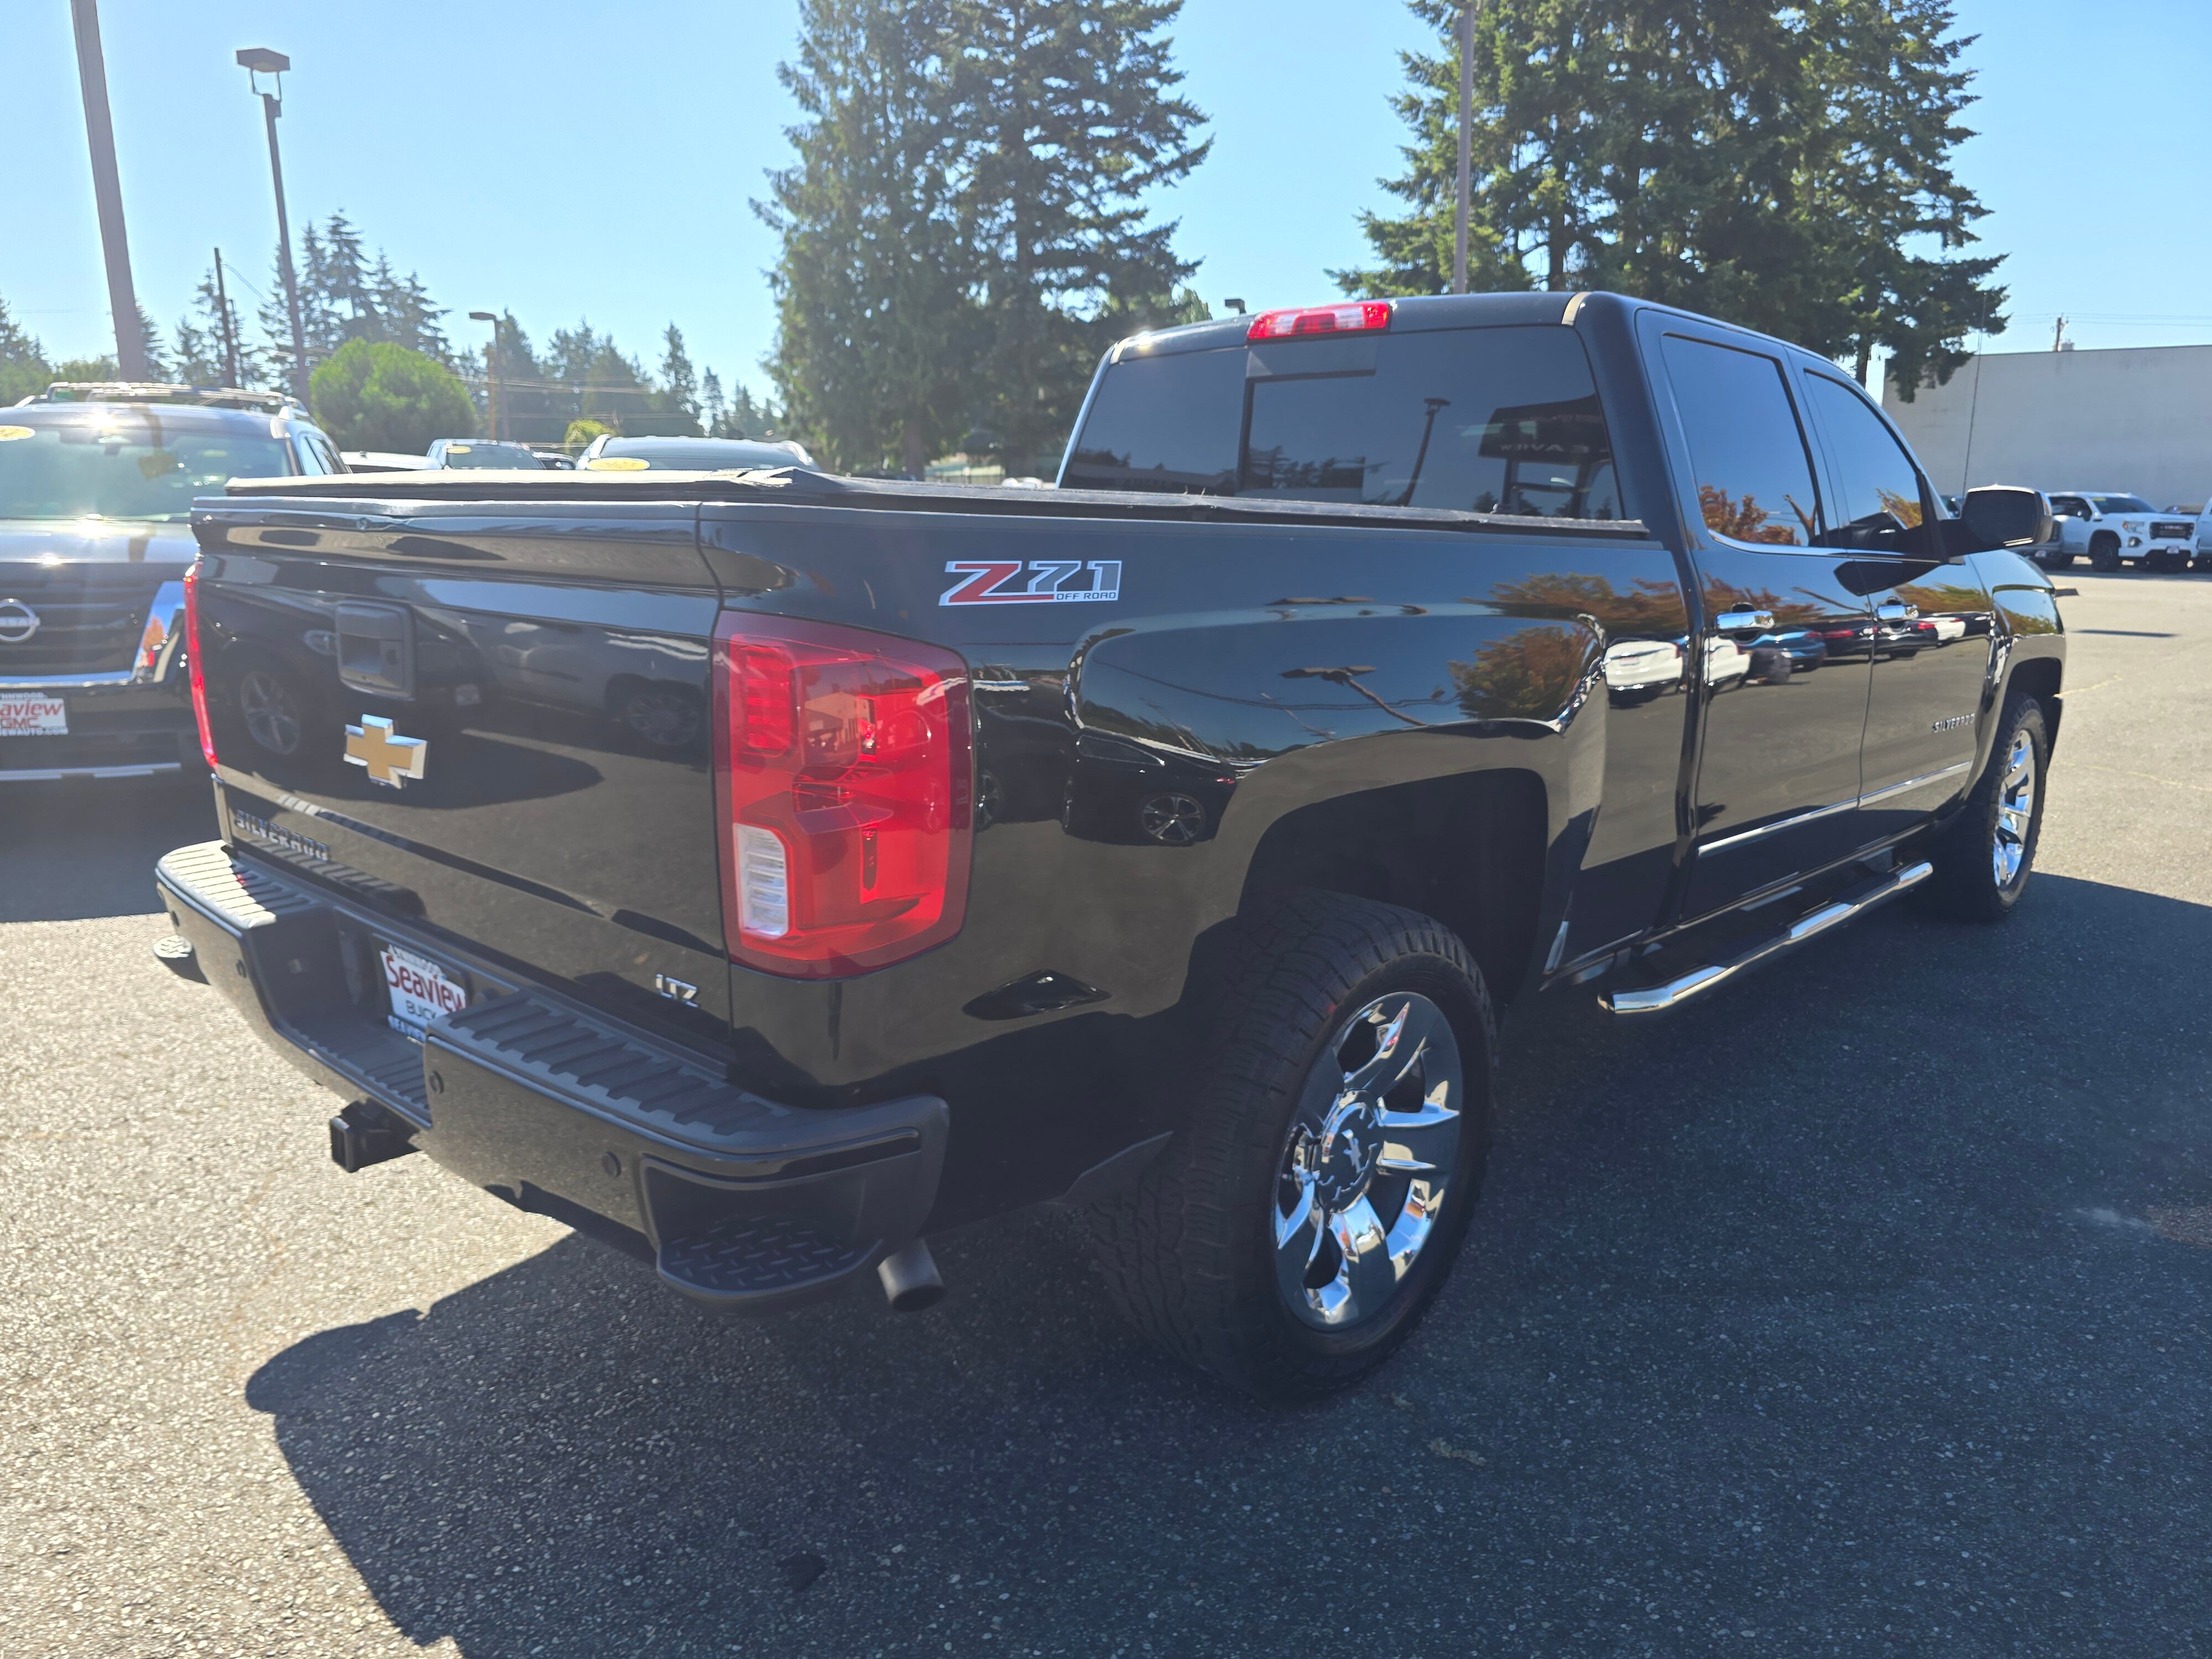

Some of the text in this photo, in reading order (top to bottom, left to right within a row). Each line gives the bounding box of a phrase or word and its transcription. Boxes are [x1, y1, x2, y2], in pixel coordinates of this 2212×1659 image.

[938, 560, 1122, 606] Z71
[0, 727, 67, 736] EWAUTO.COM
[1, 718, 41, 728] GMC
[236, 809, 329, 862] SILVERADO
[656, 974, 698, 1008] LTZ
